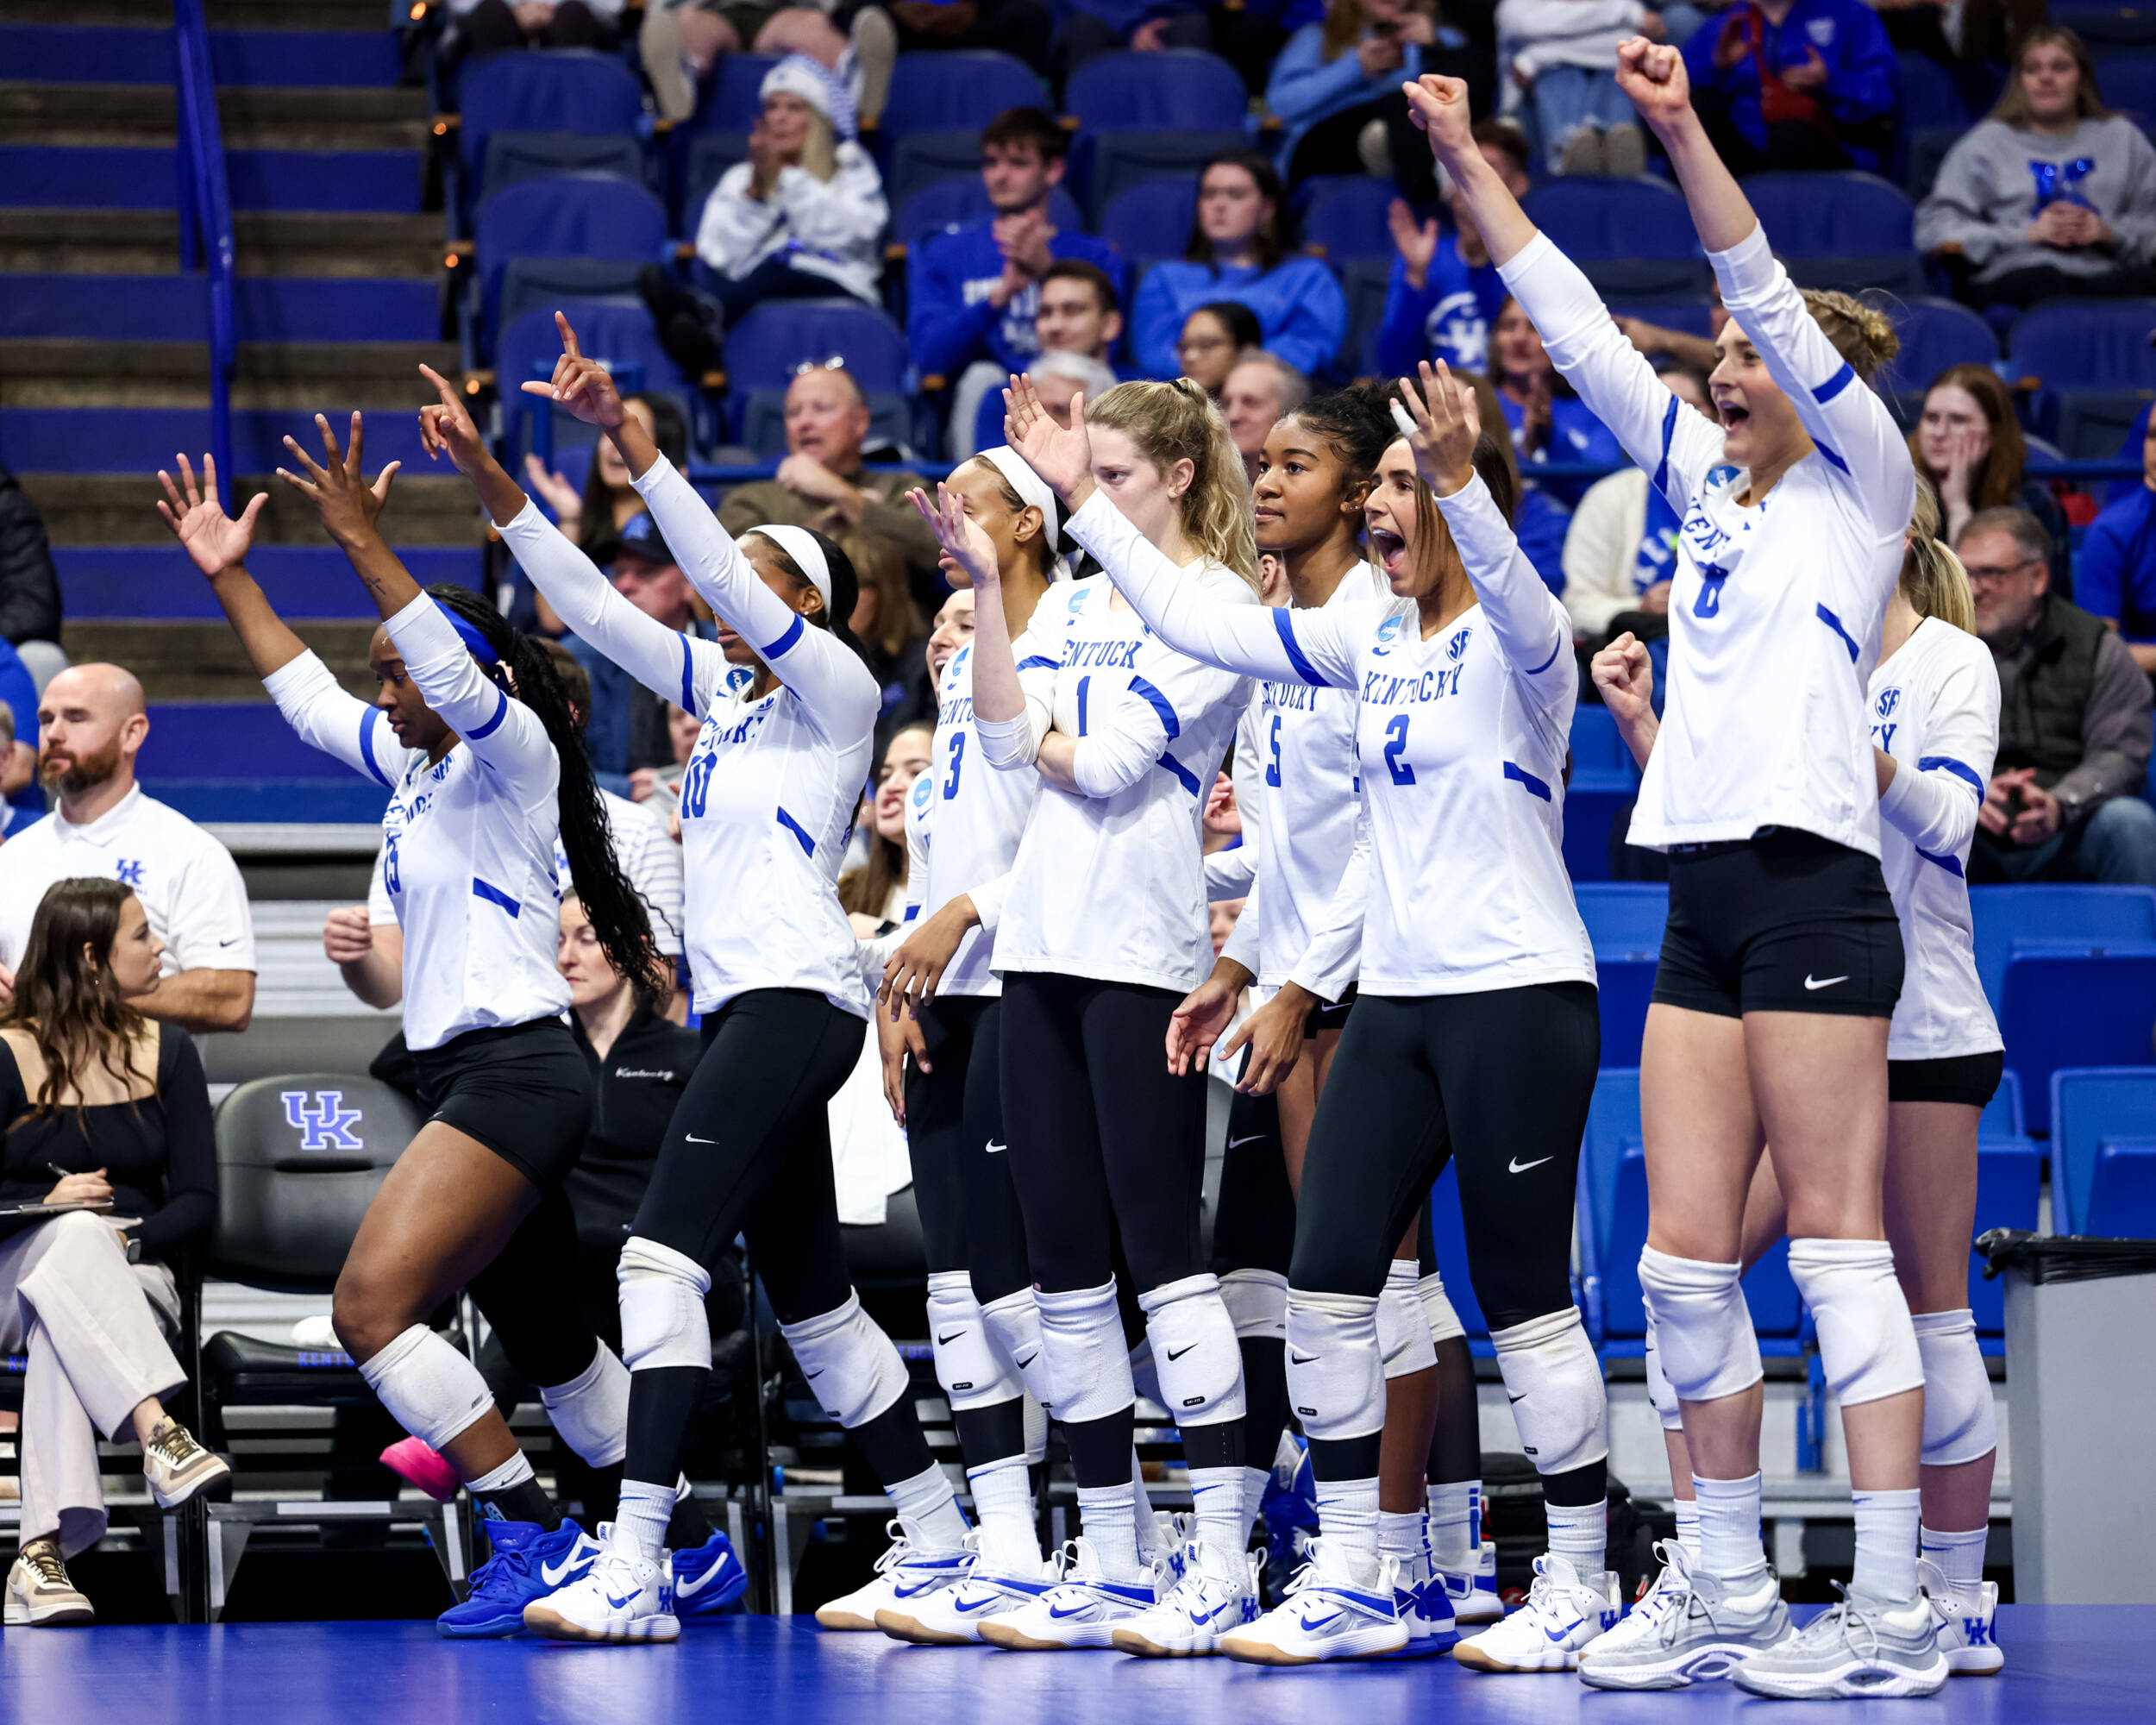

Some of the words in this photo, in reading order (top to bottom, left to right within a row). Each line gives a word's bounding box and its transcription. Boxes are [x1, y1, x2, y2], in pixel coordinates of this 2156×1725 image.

[1076, 675, 1091, 737] 1
[943, 731, 966, 800] 3
[1265, 714, 1282, 788] 5
[1383, 713, 1417, 786] 2
[681, 751, 718, 819] 10
[280, 1090, 364, 1151] UK
